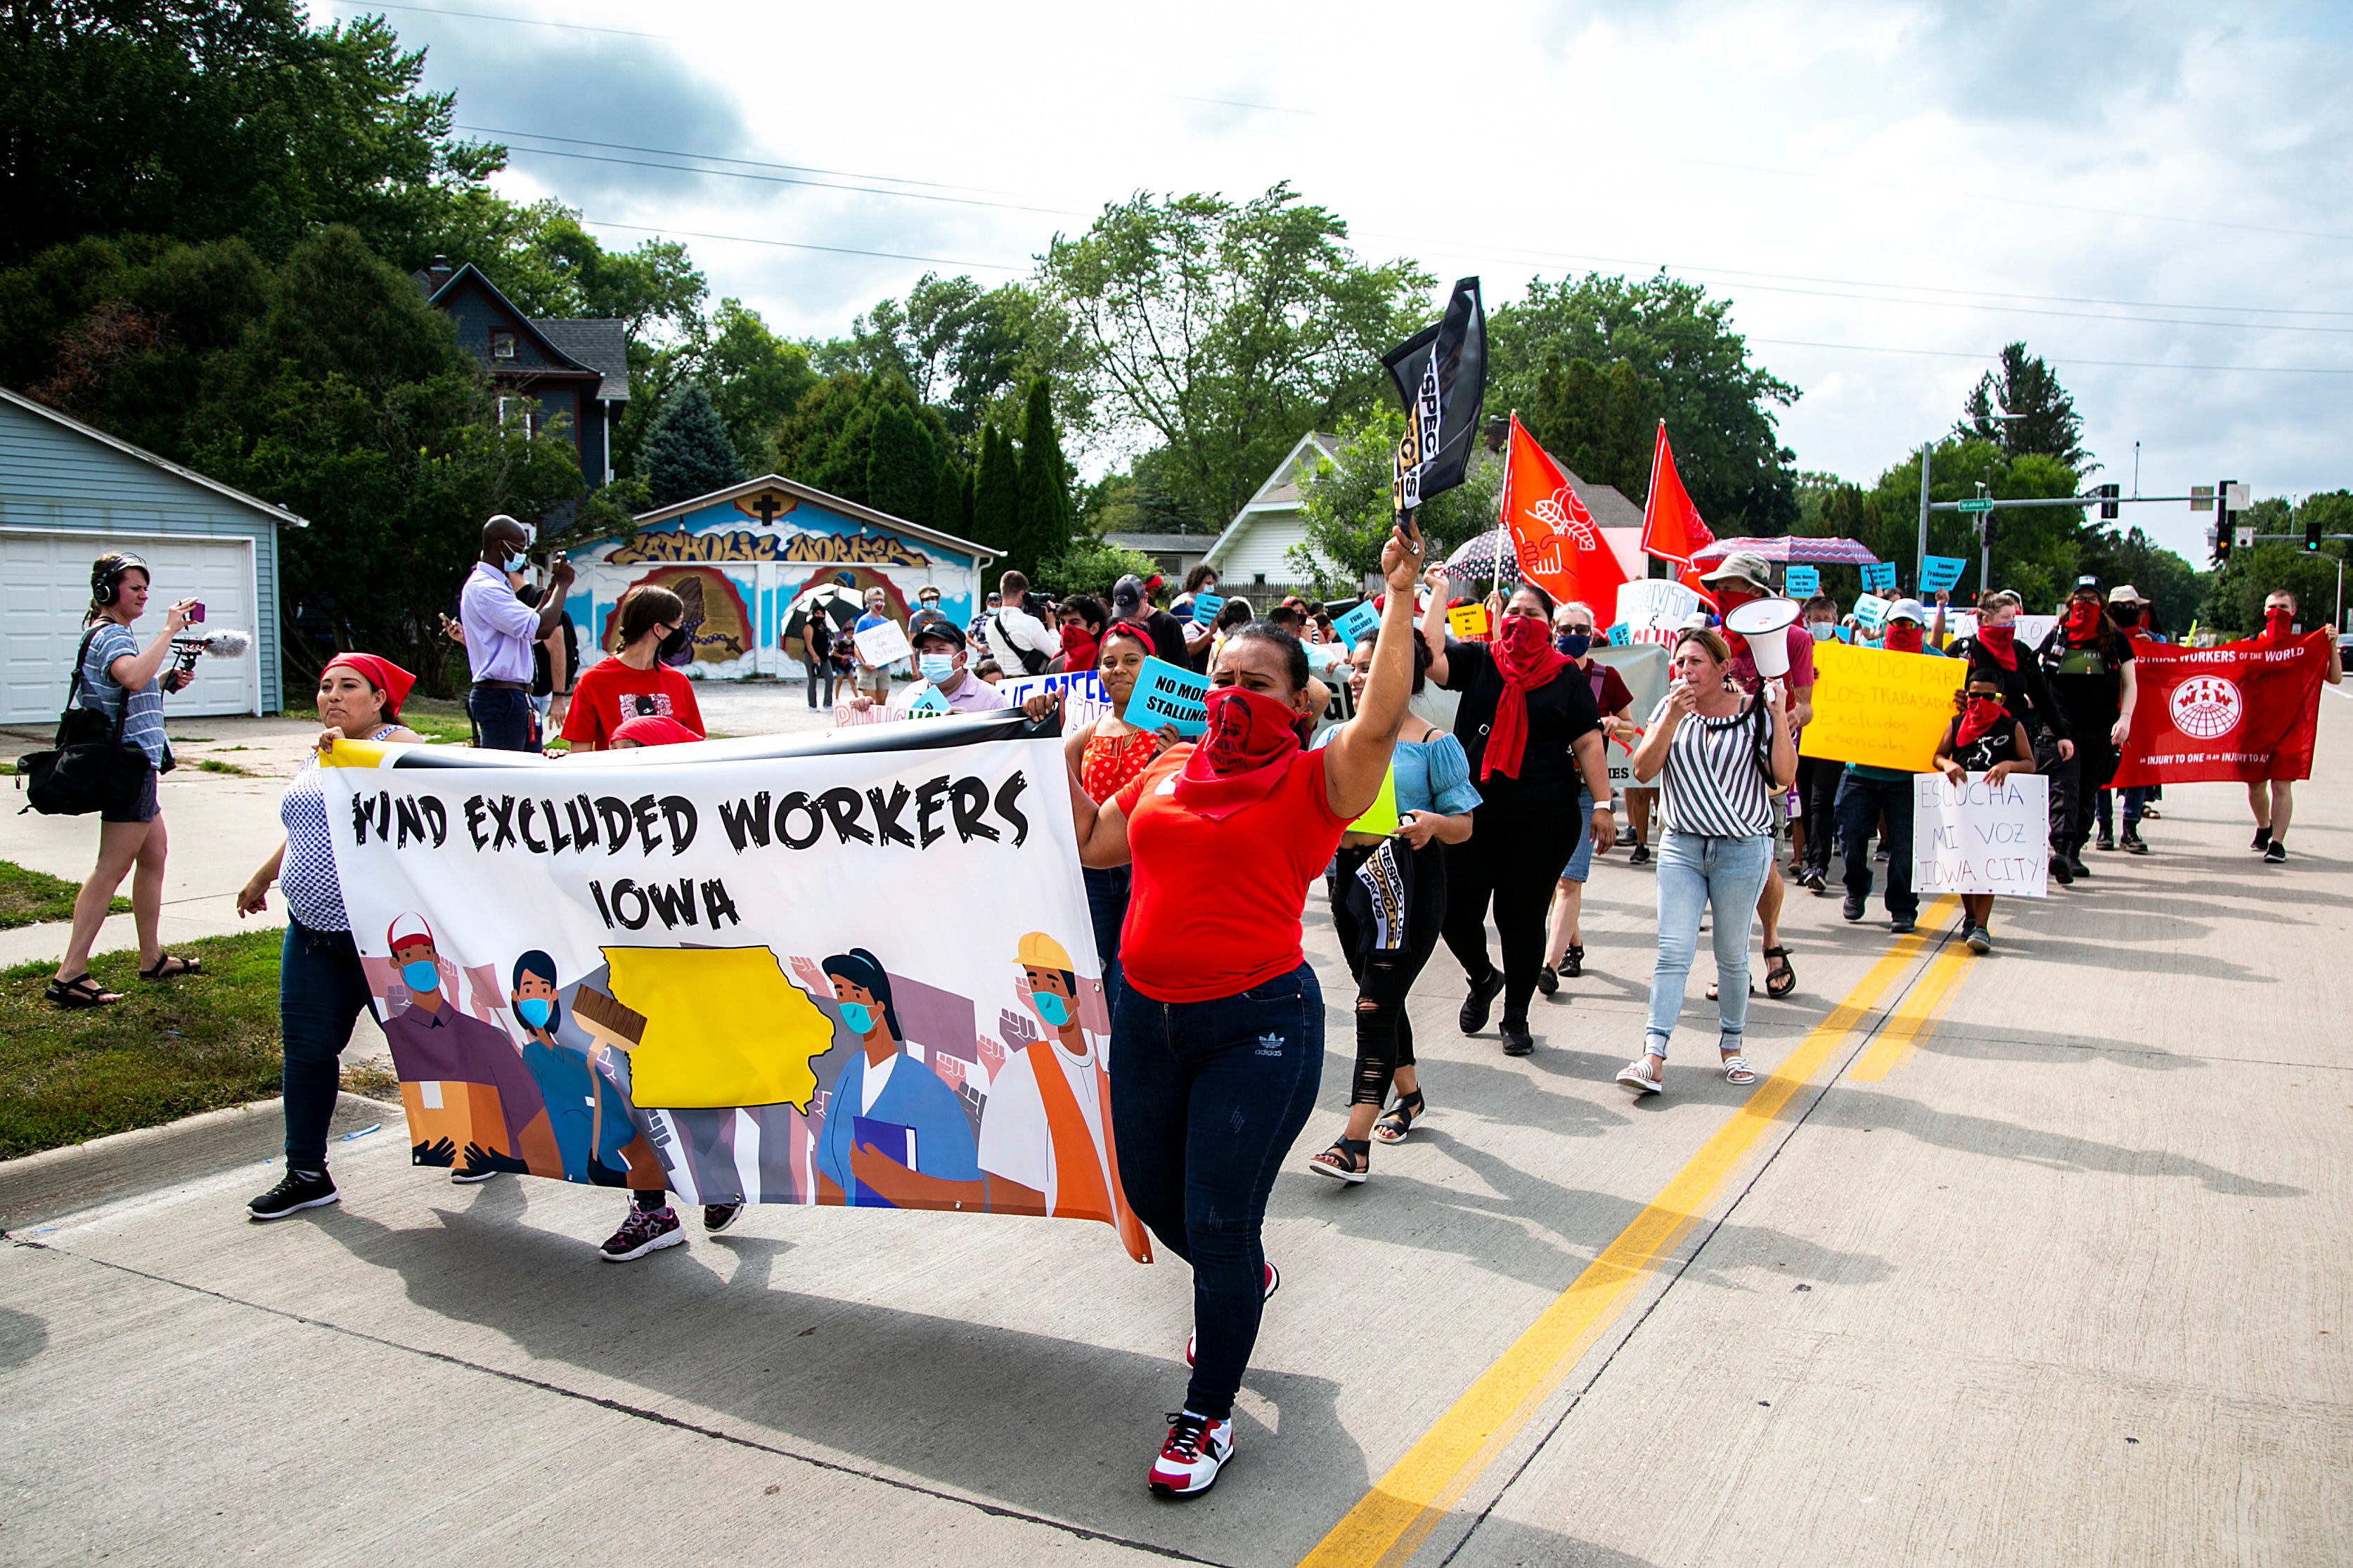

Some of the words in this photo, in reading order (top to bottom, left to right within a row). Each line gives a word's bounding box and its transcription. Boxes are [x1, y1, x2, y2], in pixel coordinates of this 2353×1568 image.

[787, 532, 928, 566] WORKER
[1348, 617, 1373, 635] EXCLUDED
[1350, 612, 1363, 623] FUND
[1822, 647, 1907, 679] FONDO
[1920, 663, 1964, 687] PARA
[2180, 650, 2236, 663] WORKERS
[2265, 647, 2304, 662] WORLD
[1155, 675, 1175, 694] NO
[1824, 680, 1864, 703] LOS
[1146, 696, 1208, 723] STALLING
[2147, 754, 2174, 765] INJURY
[2176, 754, 2185, 764] TO
[2187, 753, 2205, 763] ONE
[2222, 752, 2248, 763] INJURY
[1921, 780, 2023, 808] ESCUCHA
[464, 793, 698, 857] EXCLUDED
[718, 770, 1029, 855] WORKERS
[1932, 825, 1959, 850] MI
[1974, 822, 2027, 845] VOZ
[1919, 860, 1976, 885] IOWA
[1985, 857, 2039, 882] CITY
[588, 878, 741, 931] IOWA
[1360, 873, 1379, 896] PAY
[1372, 898, 1385, 920] US
[1381, 845, 1404, 913] RESPECT
[1397, 917, 1403, 941] US
[1388, 922, 1397, 943] US
[1255, 1048, 1282, 1056] adidas
